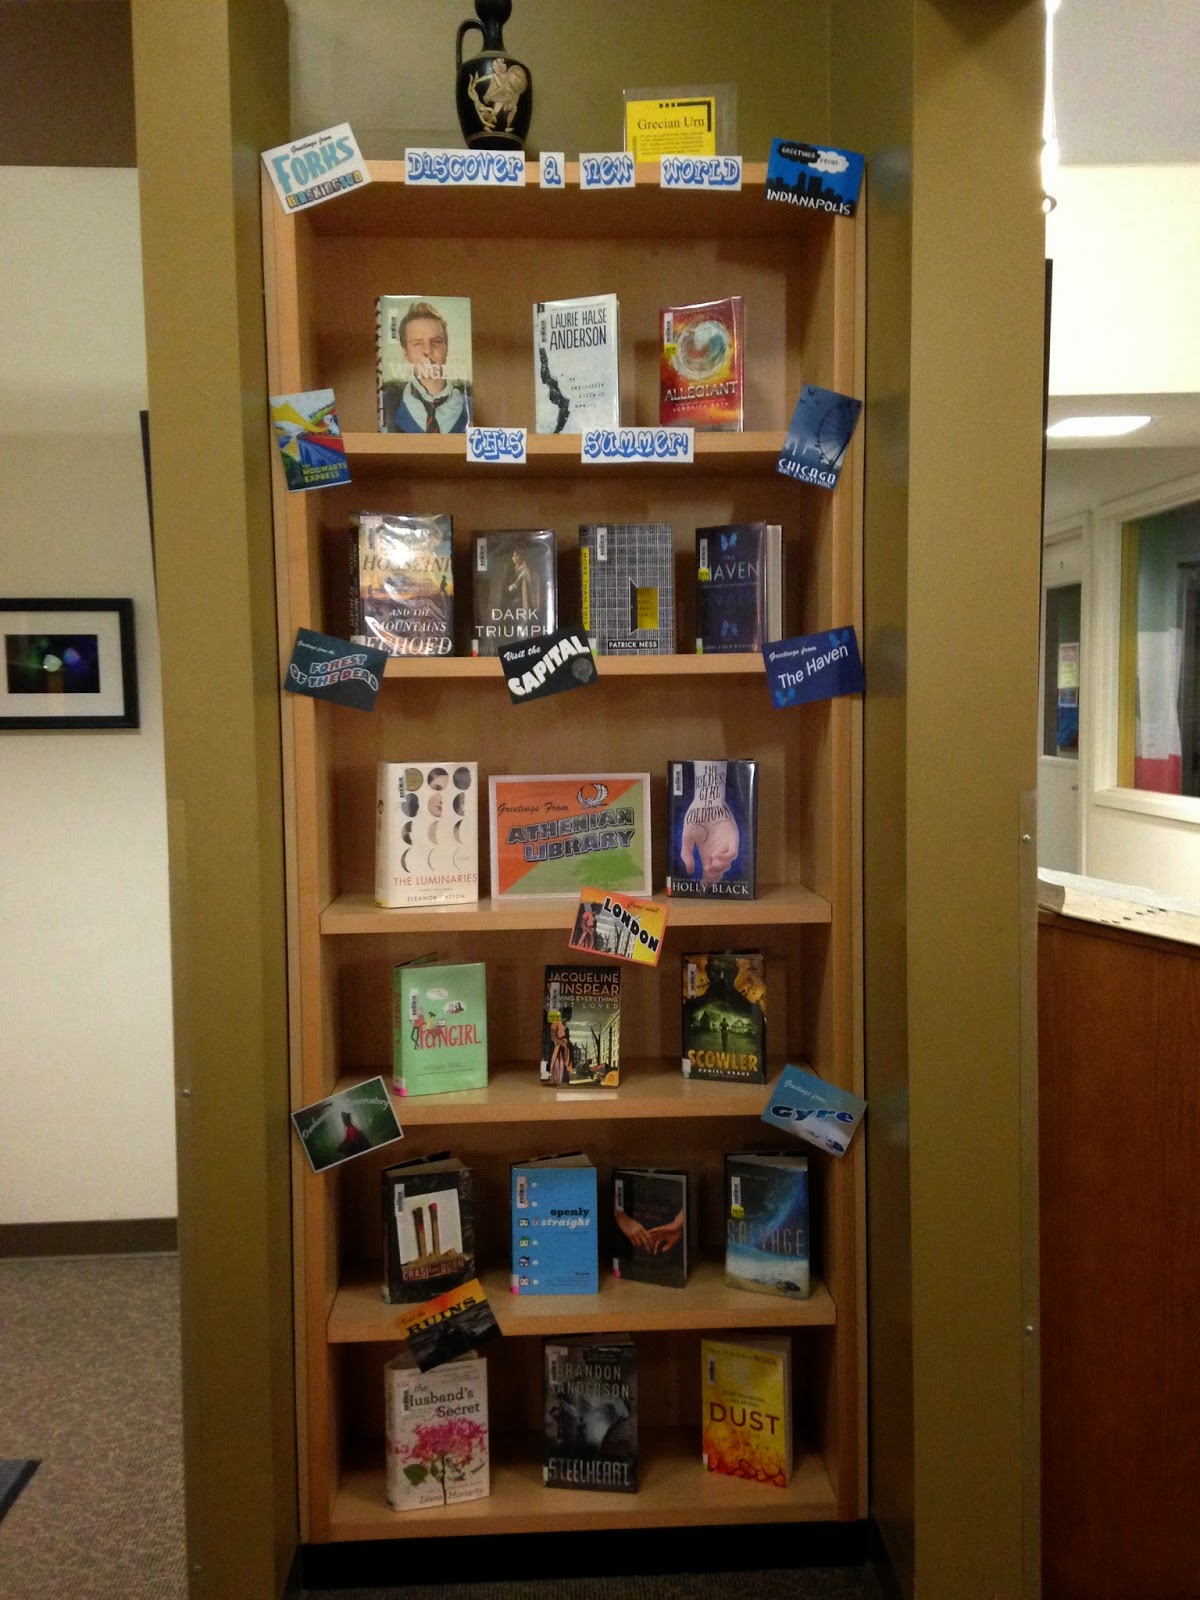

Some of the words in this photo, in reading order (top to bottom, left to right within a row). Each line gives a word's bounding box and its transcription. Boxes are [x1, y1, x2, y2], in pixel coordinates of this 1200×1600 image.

[637, 117, 680, 130] Grecian
[684, 116, 705, 128] Urn
[543, 155, 562, 186] a
[766, 188, 851, 216] INDIANAPOLIS
[550, 311, 579, 329] LAURIE
[582, 308, 607, 326] HALSE
[550, 325, 607, 351] ANDERSON
[665, 380, 738, 402] ALLEGIANT
[672, 403, 708, 413] VERONICA
[711, 400, 730, 408] ROTH
[302, 462, 348, 475] HOGWARTS
[304, 470, 340, 483] EXPRESS
[778, 458, 837, 485] CHICAGO
[389, 608, 410, 616] AND
[413, 608, 431, 616] THE
[492, 608, 539, 620] DARK
[376, 620, 447, 633] MOUNTAINS
[503, 649, 526, 662] Visit
[527, 644, 542, 656] the
[609, 641, 637, 649] PATRICK
[639, 641, 658, 649] NESS
[769, 649, 800, 662] Greetings
[801, 645, 817, 656] from
[309, 653, 368, 674] FOREST
[508, 635, 591, 696] CAPITAL
[778, 669, 804, 689] The
[806, 645, 849, 676] Haven
[290, 663, 308, 685] OF
[308, 671, 340, 688] THE
[340, 667, 379, 691] DEAD
[699, 785, 721, 801] GIRL
[497, 802, 540, 816] Greetings
[543, 802, 569, 813] From
[686, 804, 731, 825] COLDTOWN
[506, 806, 635, 844] ATHENIAN
[523, 828, 636, 863] LIBRARY
[394, 876, 412, 887] THE
[415, 873, 478, 886] LUMINARIES
[672, 882, 708, 893] HOLLY
[712, 883, 749, 895] BLACK
[407, 894, 437, 902] ELEANOR
[603, 896, 660, 953] LONDON
[548, 972, 619, 983] JACQUELINE
[548, 983, 619, 996] INSPEAR
[576, 995, 618, 1003] EVERYTHING
[687, 1049, 759, 1072] SCOWLER
[550, 1207, 590, 1217] openly
[541, 1218, 591, 1230] straight
[407, 1296, 477, 1335] RUINS
[556, 1362, 622, 1380] BRANDON
[414, 1383, 428, 1392] the
[550, 1379, 630, 1398] SANDERSON
[437, 1403, 480, 1418] Secret
[710, 1401, 780, 1435] DUST
[548, 1458, 630, 1486] STEELHEART
